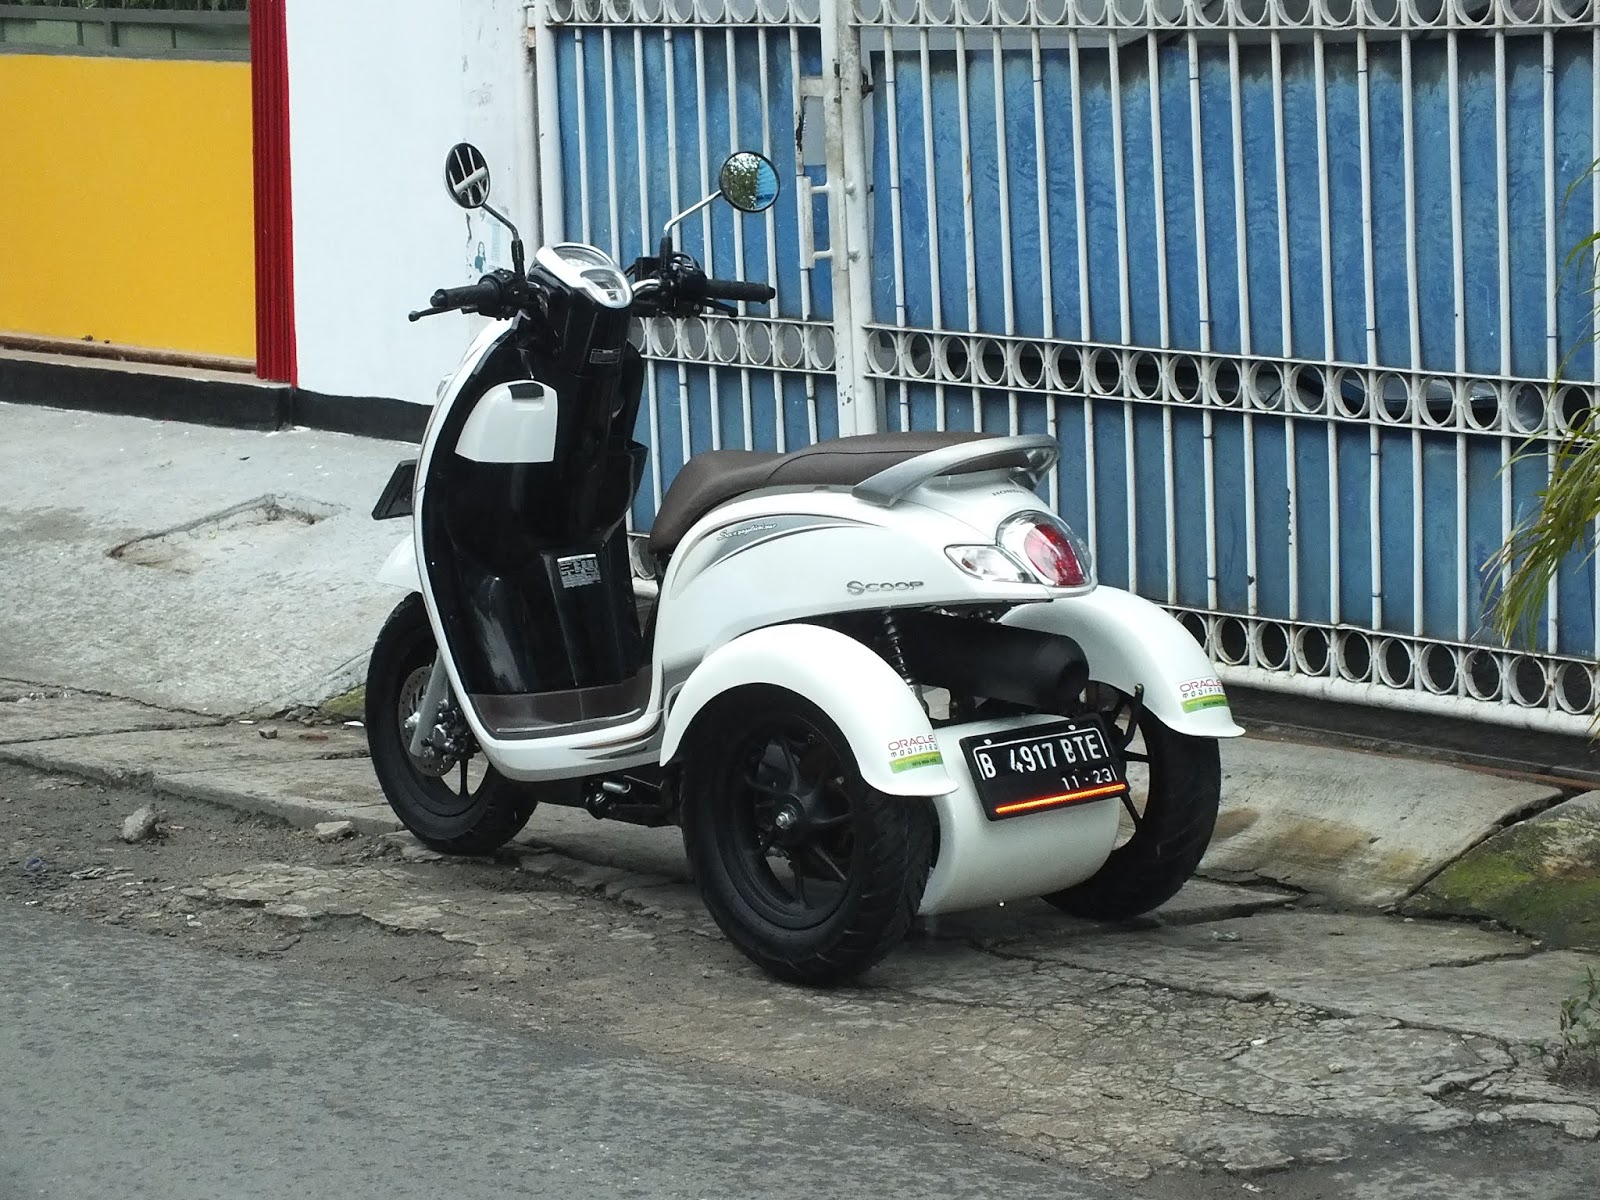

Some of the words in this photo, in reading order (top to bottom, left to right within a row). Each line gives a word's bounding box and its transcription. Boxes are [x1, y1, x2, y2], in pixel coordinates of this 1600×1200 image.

[1179, 678, 1222, 692] ORACLE
[888, 734, 935, 751] ORACLE
[979, 752, 997, 779] B
[1009, 742, 1058, 774] 4917
[1059, 734, 1102, 764] BTE
